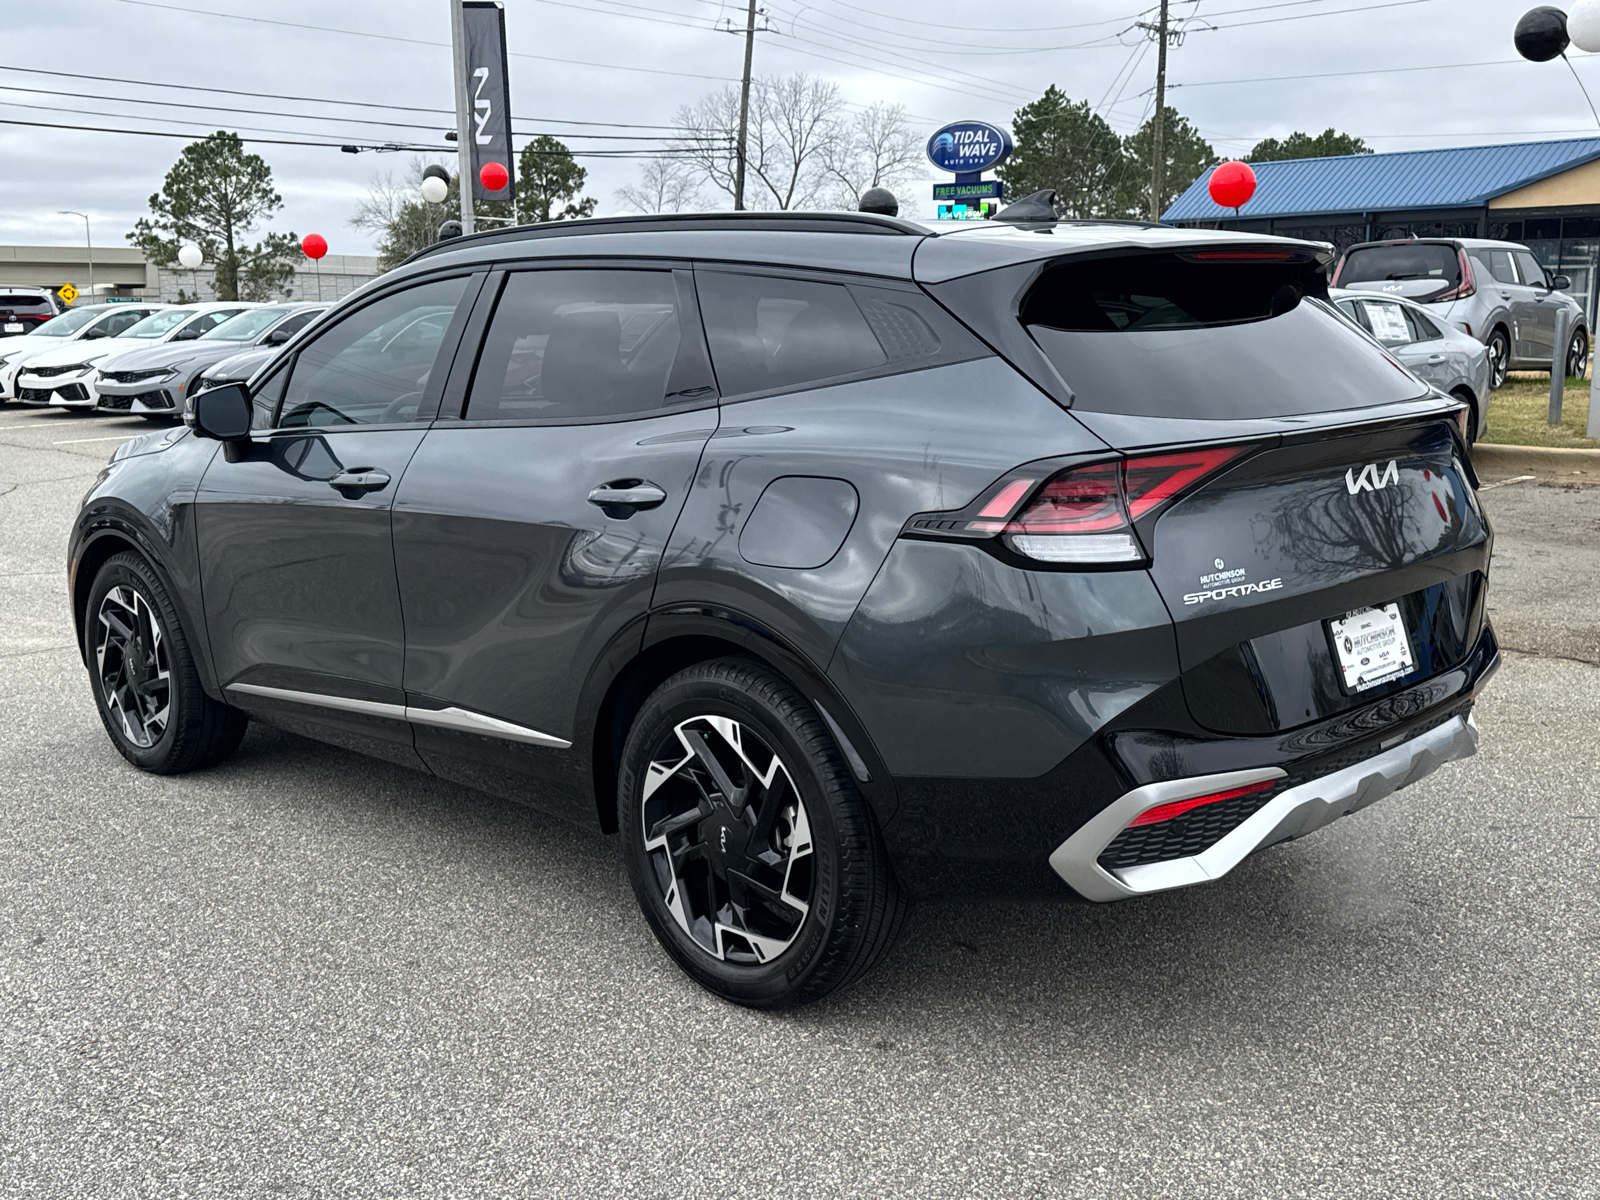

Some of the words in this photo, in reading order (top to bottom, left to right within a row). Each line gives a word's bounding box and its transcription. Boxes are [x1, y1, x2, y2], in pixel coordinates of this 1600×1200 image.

[473, 67, 493, 144] KIA
[954, 130, 990, 144] TIDAL
[959, 143, 997, 157] WAVE
[935, 186, 955, 196] FREE
[956, 184, 993, 195] VACUUMS
[1345, 460, 1399, 495] KIA
[1200, 568, 1245, 584] HUTCHINSON
[1203, 579, 1231, 589] AUTOMOTIVE
[1183, 578, 1283, 605] SPORTAGE
[1353, 626, 1397, 648] HUTCHINSON
[1357, 642, 1382, 655] AUTOMOTIVE
[1383, 637, 1396, 647] GROUP
[622, 771, 634, 857] MICHELIN
[817, 822, 830, 920] MICHELIN
[801, 930, 820, 965] 235/55
